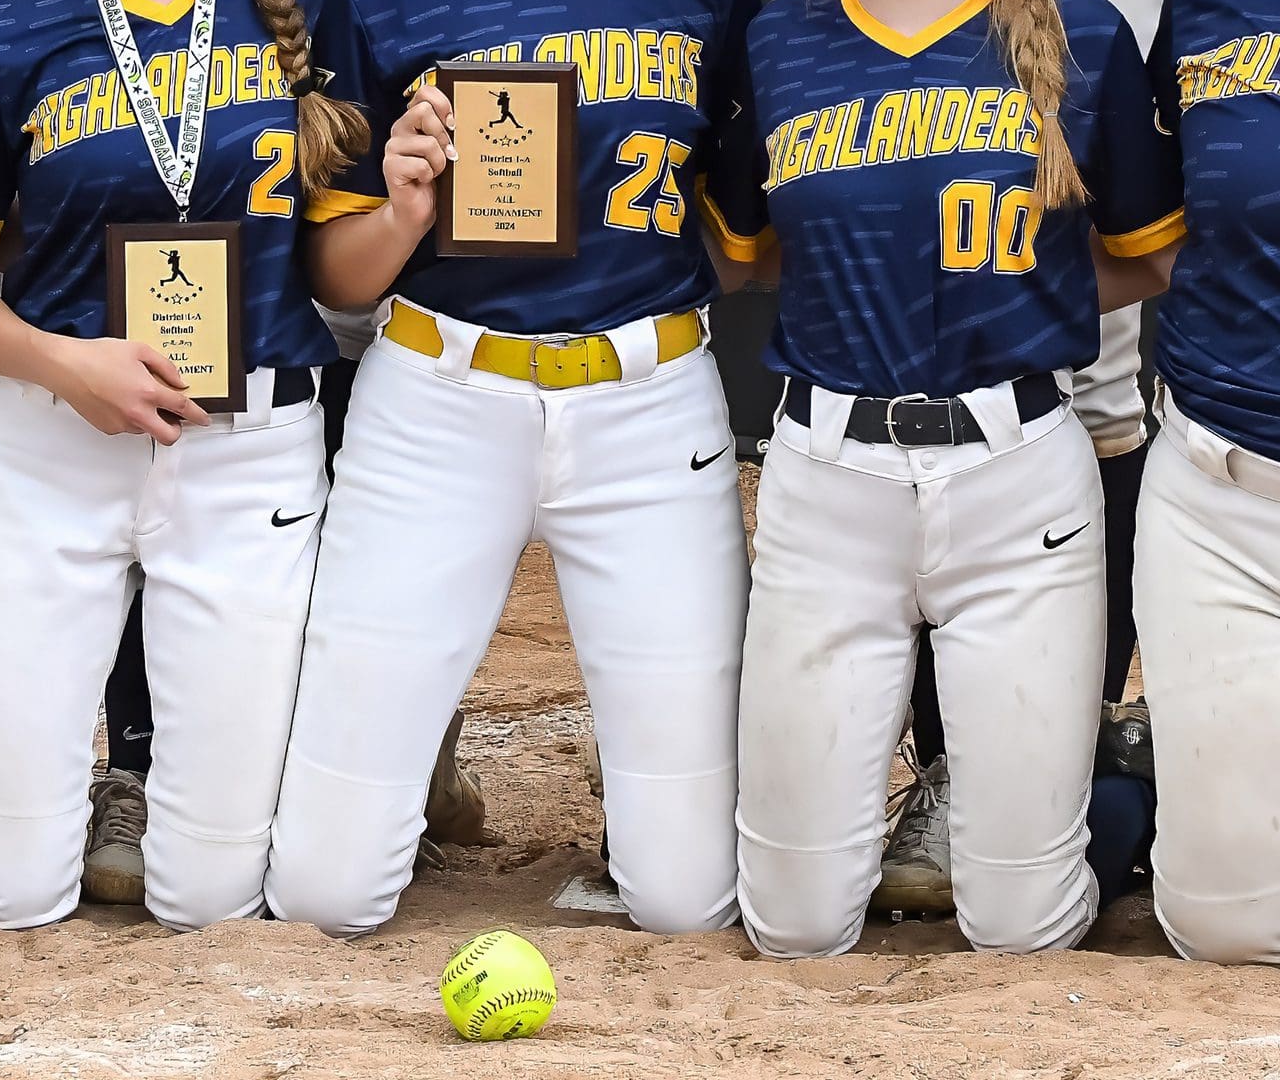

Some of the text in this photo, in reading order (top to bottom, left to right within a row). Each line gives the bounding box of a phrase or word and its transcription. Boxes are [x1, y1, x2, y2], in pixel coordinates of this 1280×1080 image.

[181, 73, 205, 154] SOFTBALL
[136, 97, 177, 179] SOFTBALL
[480, 154, 513, 163] District
[247, 129, 297, 218] 2
[487, 167, 522, 177] Softball
[603, 130, 693, 238] 25
[494, 195, 516, 204] ALL
[467, 207, 543, 217] TOURNAMENT
[939, 178, 1045, 275] 00
[152, 313, 184, 322] District
[160, 325, 194, 335] Softball
[168, 352, 189, 361] ALL
